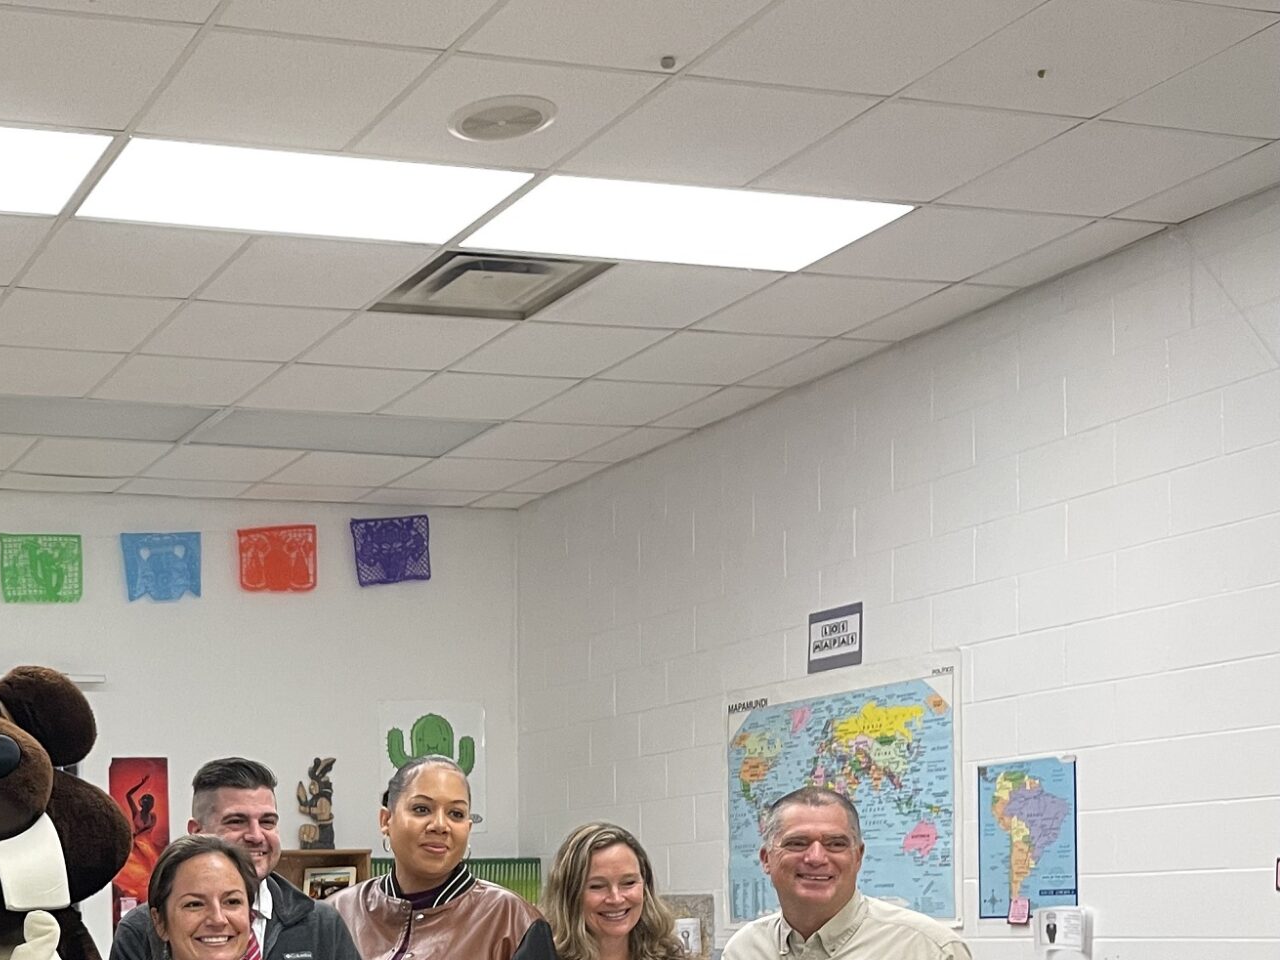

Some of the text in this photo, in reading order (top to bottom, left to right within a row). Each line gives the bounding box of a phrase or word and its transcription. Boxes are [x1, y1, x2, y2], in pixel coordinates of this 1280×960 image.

[823, 621, 847, 636] LOS
[813, 633, 856, 651] MAPAS
[728, 698, 768, 713] MAPAMUNDI
